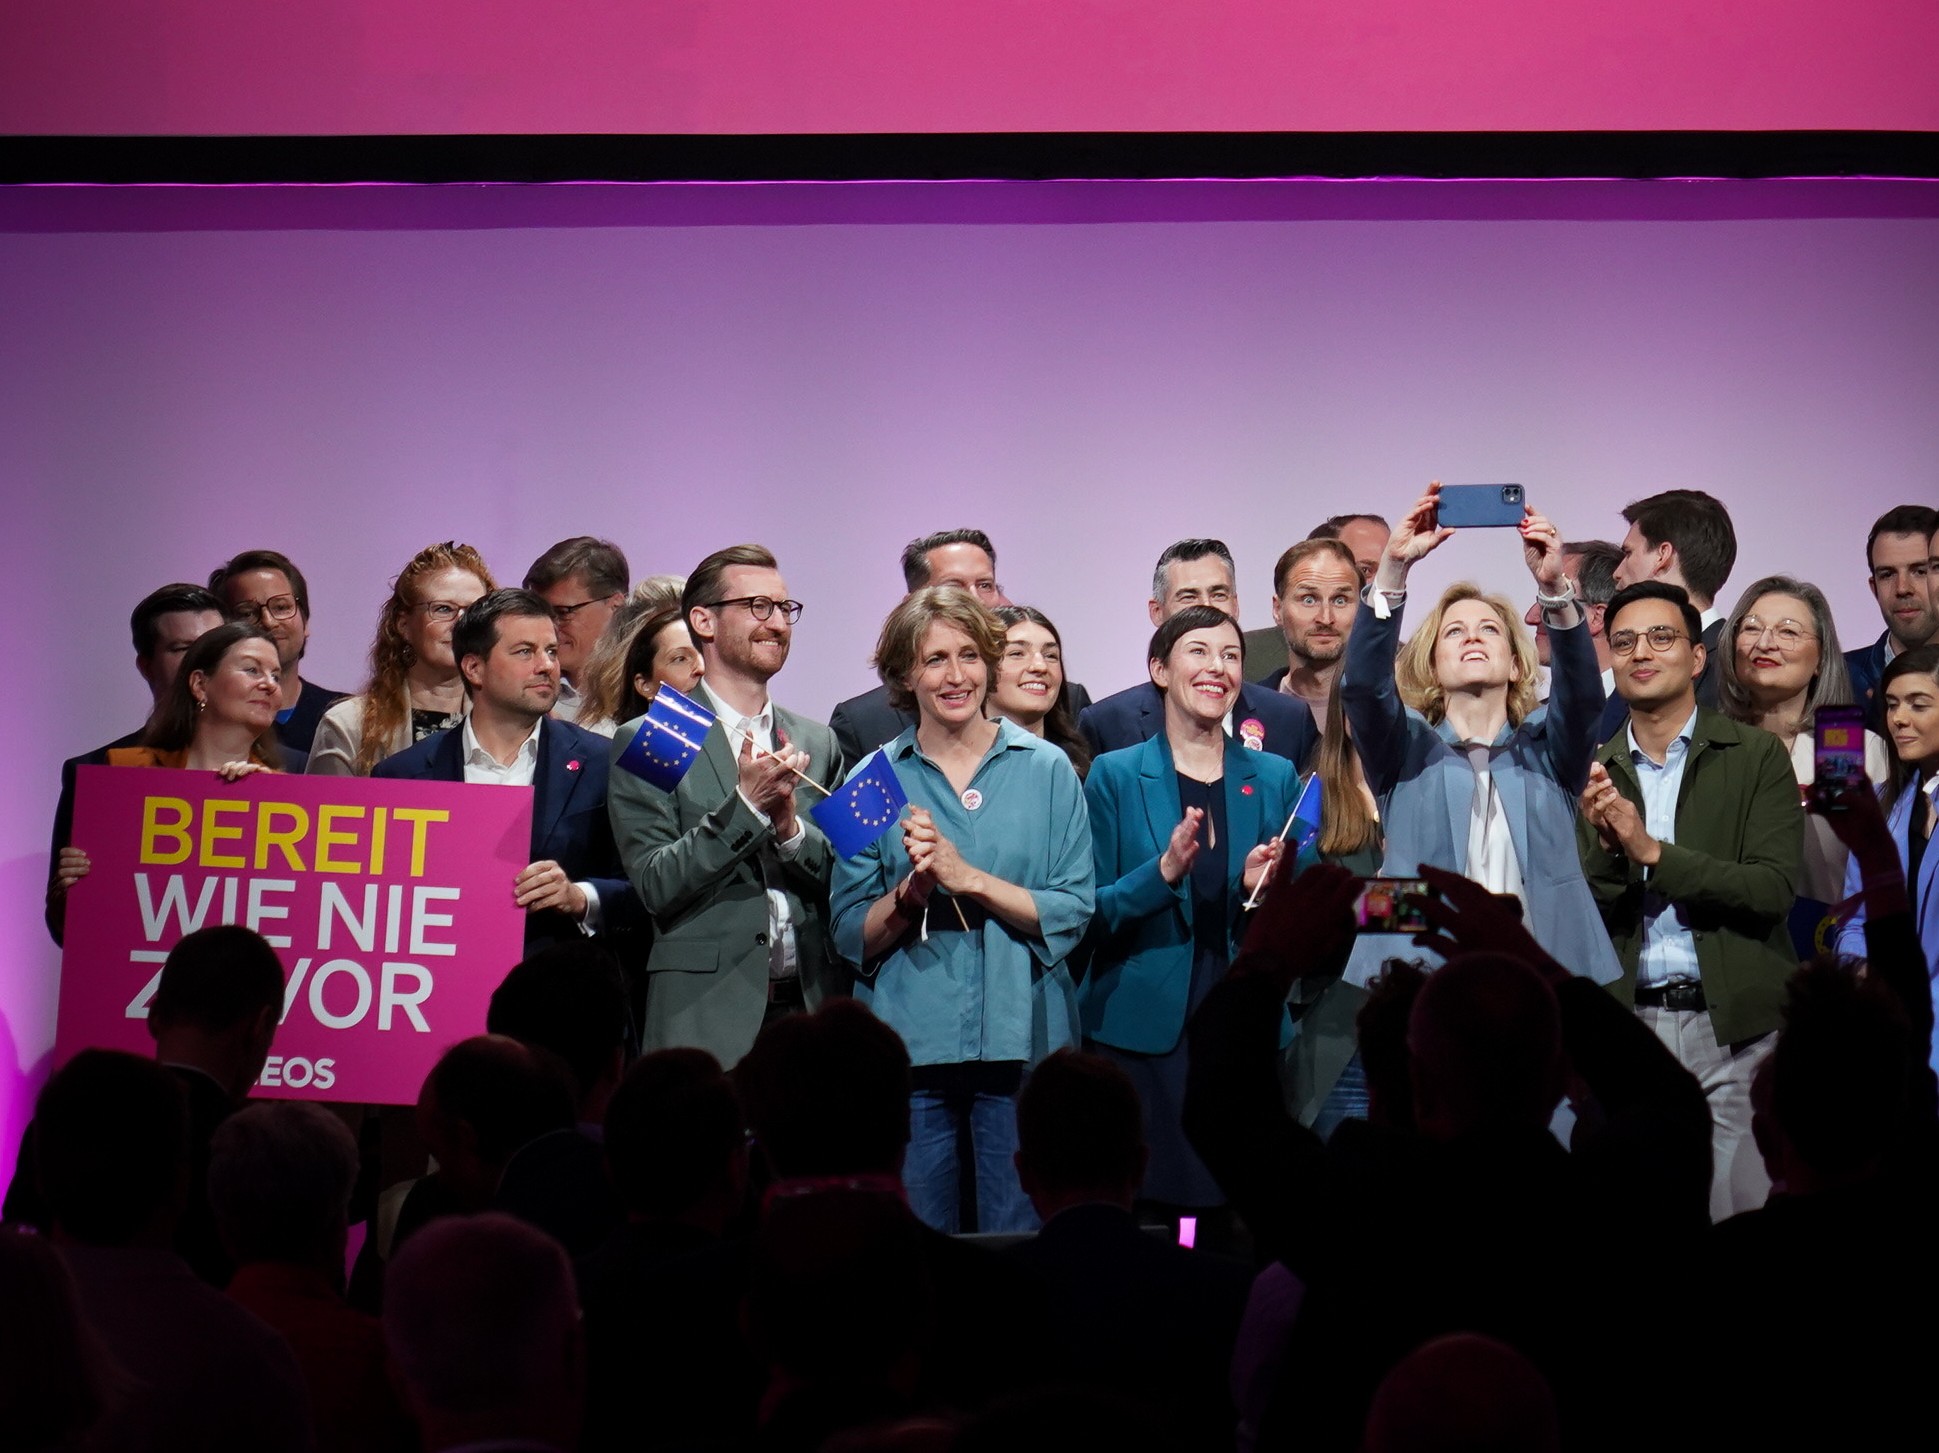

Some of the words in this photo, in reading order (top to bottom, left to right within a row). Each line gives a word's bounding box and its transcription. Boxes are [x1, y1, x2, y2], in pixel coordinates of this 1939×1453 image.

[140, 796, 449, 877] BEREIT
[133, 873, 296, 948] WIE
[317, 881, 460, 956] NIE
[125, 950, 434, 1033] ZVOR
[254, 1056, 336, 1090] EOS
